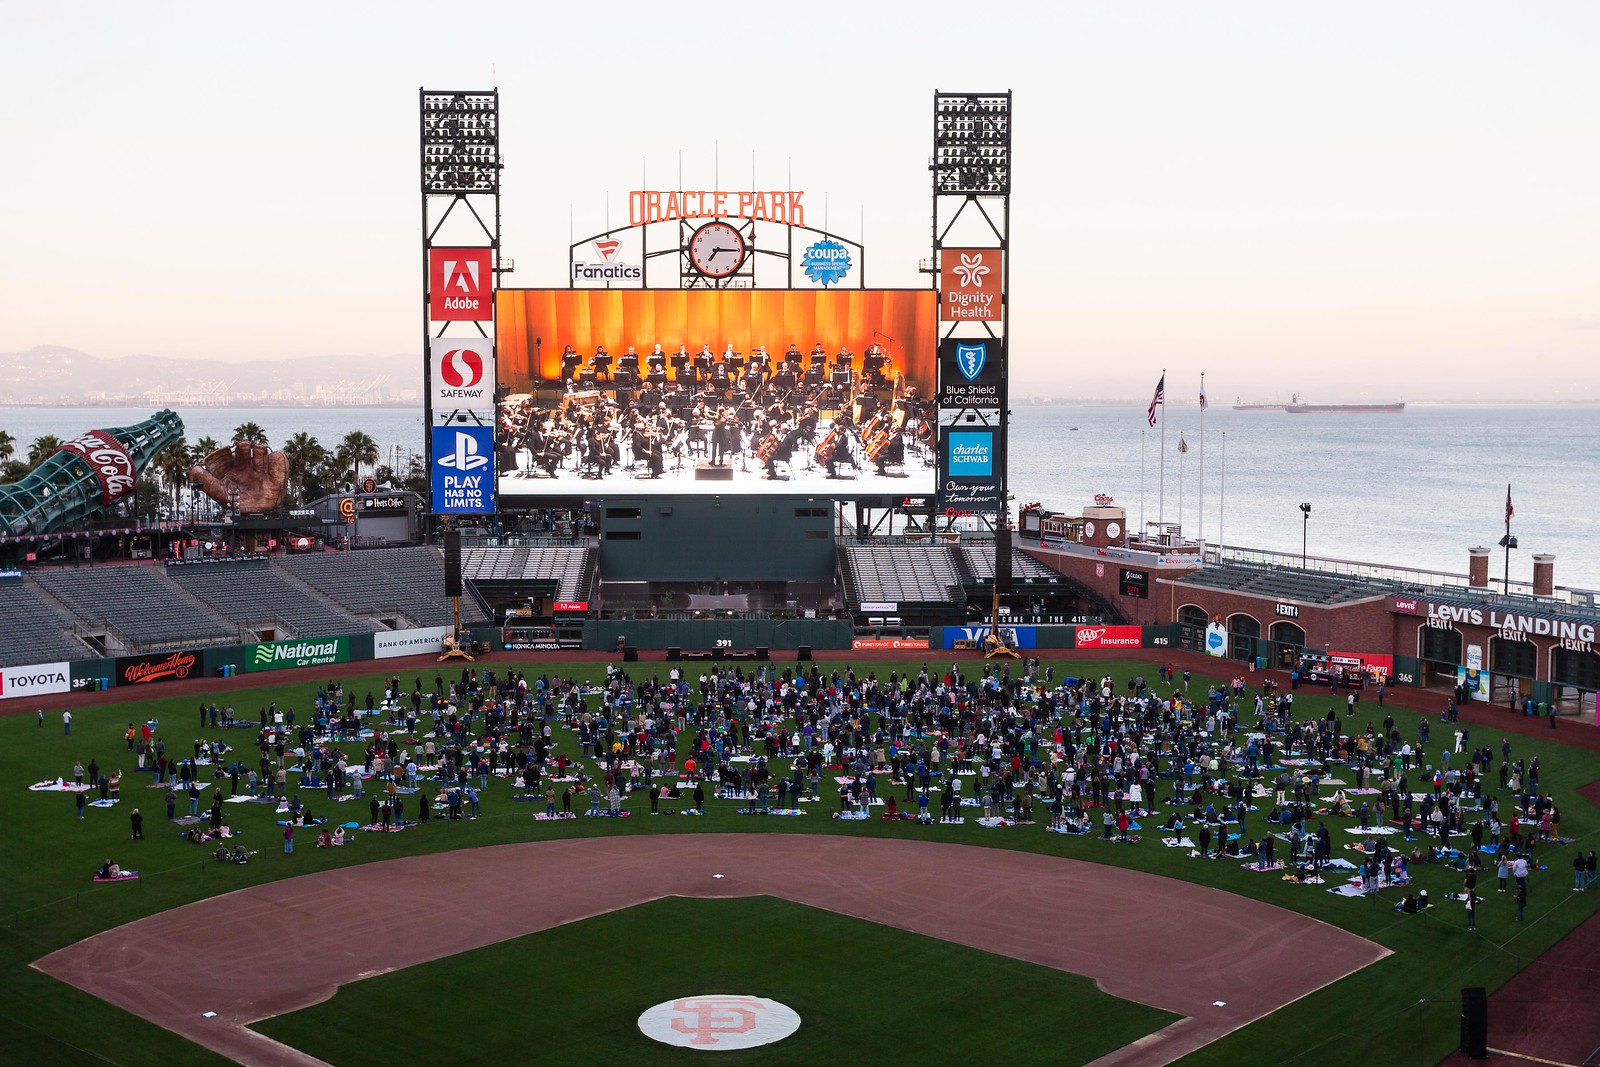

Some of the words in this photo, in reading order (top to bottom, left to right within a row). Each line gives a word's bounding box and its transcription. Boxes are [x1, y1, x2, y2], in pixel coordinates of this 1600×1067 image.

[629, 190, 728, 227] ORACLE
[738, 190, 806, 229] PARK
[808, 248, 848, 262] coupa
[574, 264, 641, 279] Fanatics
[444, 297, 479, 310] Adobe
[949, 292, 993, 307] Dignity
[441, 389, 483, 398] SAFEWAY
[946, 385, 967, 394] Blue
[969, 385, 996, 394] Shield
[943, 395, 953, 404] of
[954, 395, 999, 404] California
[952, 443, 988, 455] charles
[952, 454, 988, 463] SCHWAB
[444, 476, 481, 488] PLAY
[946, 480, 968, 491] Own
[969, 484, 995, 496] your
[444, 498, 484, 508] LIMITS.
[945, 493, 997, 503] tomorrow
[1280, 604, 1294, 617] EXIT
[1431, 618, 1447, 630] EXIT
[1490, 613, 1595, 642] LANDING
[1080, 631, 1096, 640] AAA
[1503, 629, 1522, 642] EXIT
[274, 640, 338, 660] National
[1565, 638, 1586, 652] EXIT
[124, 663, 168, 682] Welcome
[166, 650, 196, 669] Home
[312, 656, 335, 664] Rental
[9, 673, 65, 688] TOYOTA
[1399, 673, 1413, 682] 365
